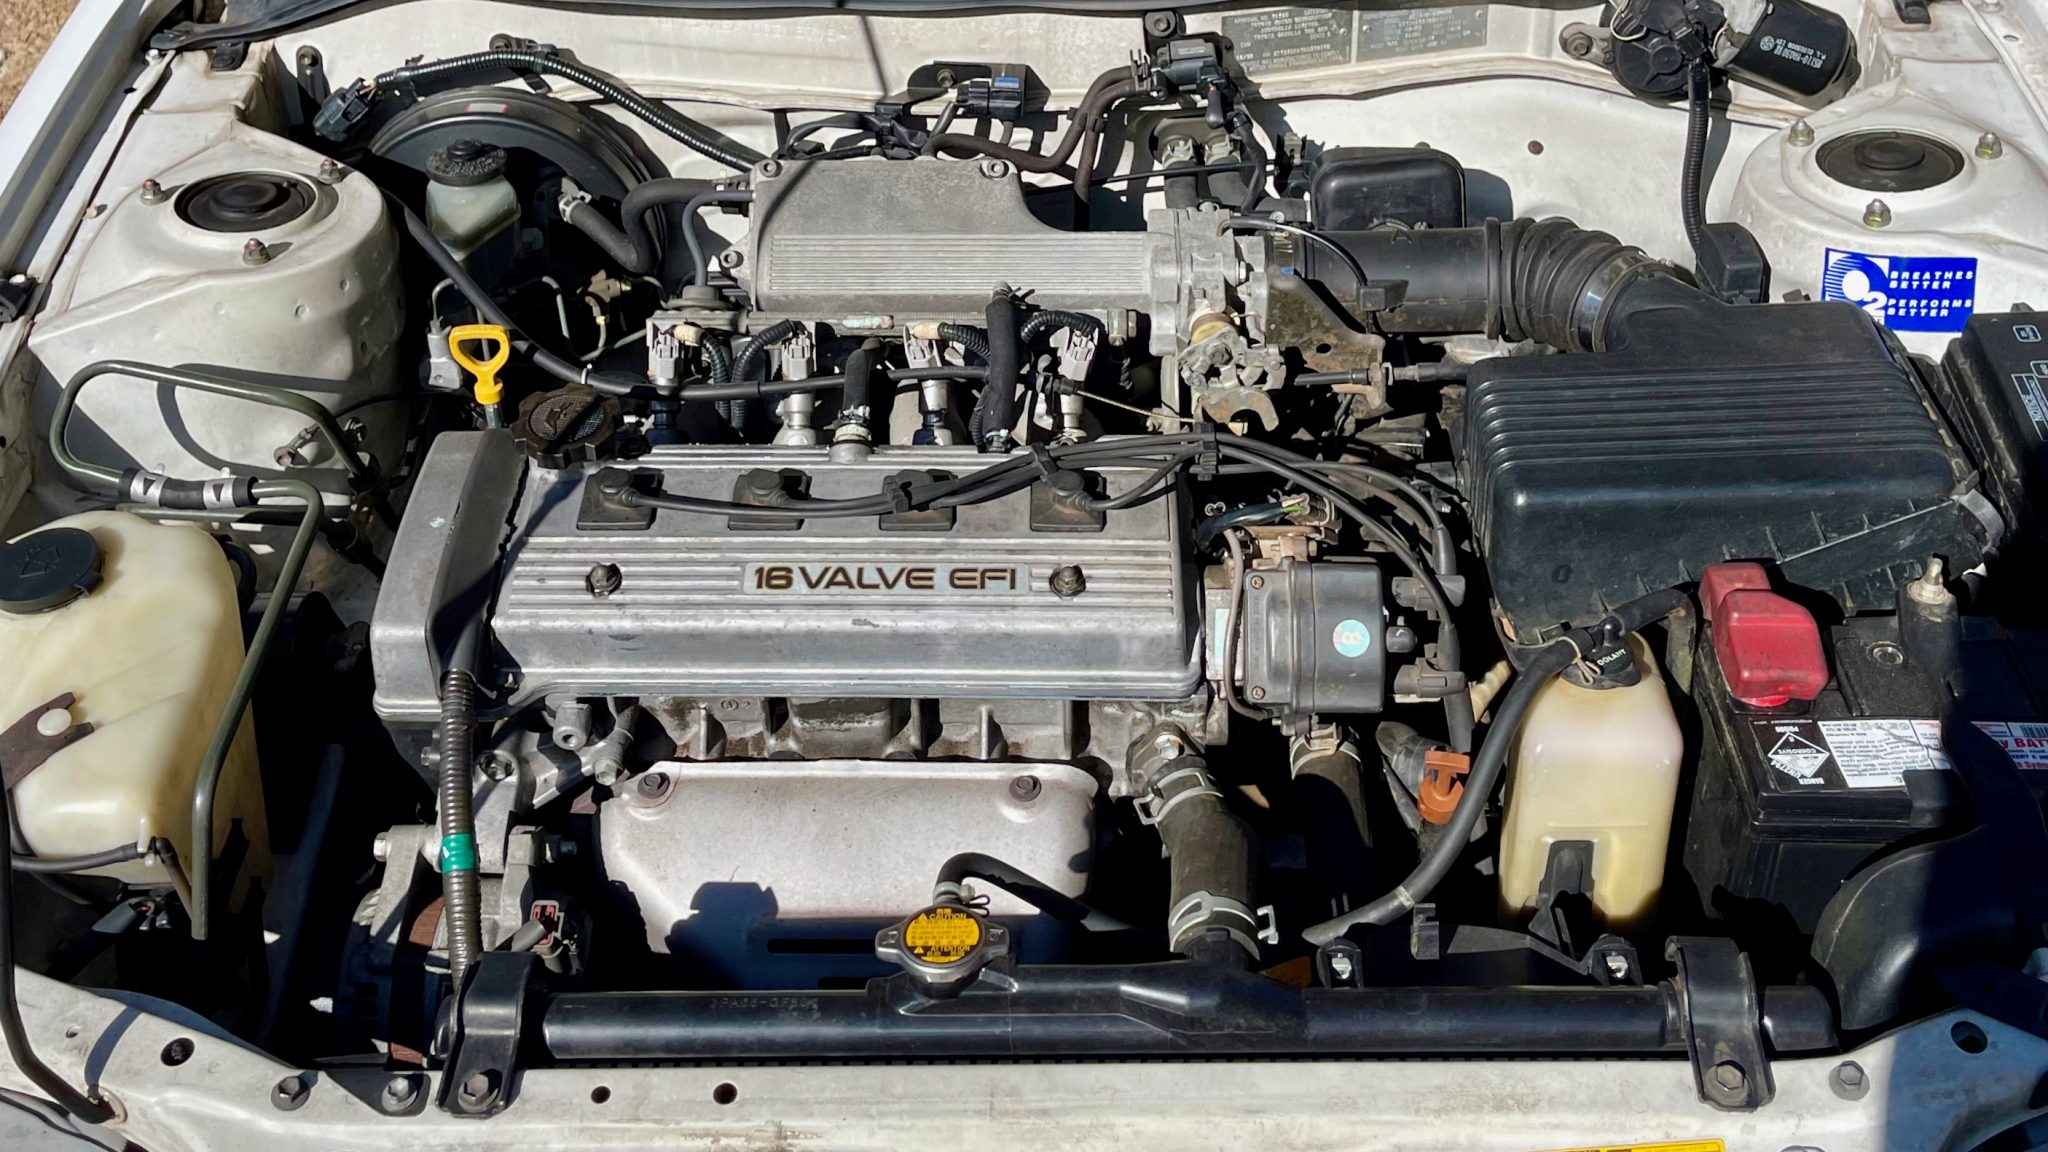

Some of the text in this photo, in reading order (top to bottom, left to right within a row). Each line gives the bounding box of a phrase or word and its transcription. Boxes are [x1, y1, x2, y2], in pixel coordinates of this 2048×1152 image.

[1890, 271, 1973, 279] BREATHES
[1889, 281, 1951, 289] BETTER
[1887, 299, 1972, 307] PERFORMS
[1887, 309, 1949, 317] BETTER
[754, 566, 1017, 590] 16 VALVE EFI
[1597, 648, 1626, 666] OOLANT
[929, 913, 967, 921] CAUTION
[931, 945, 971, 955] ATTENTION
